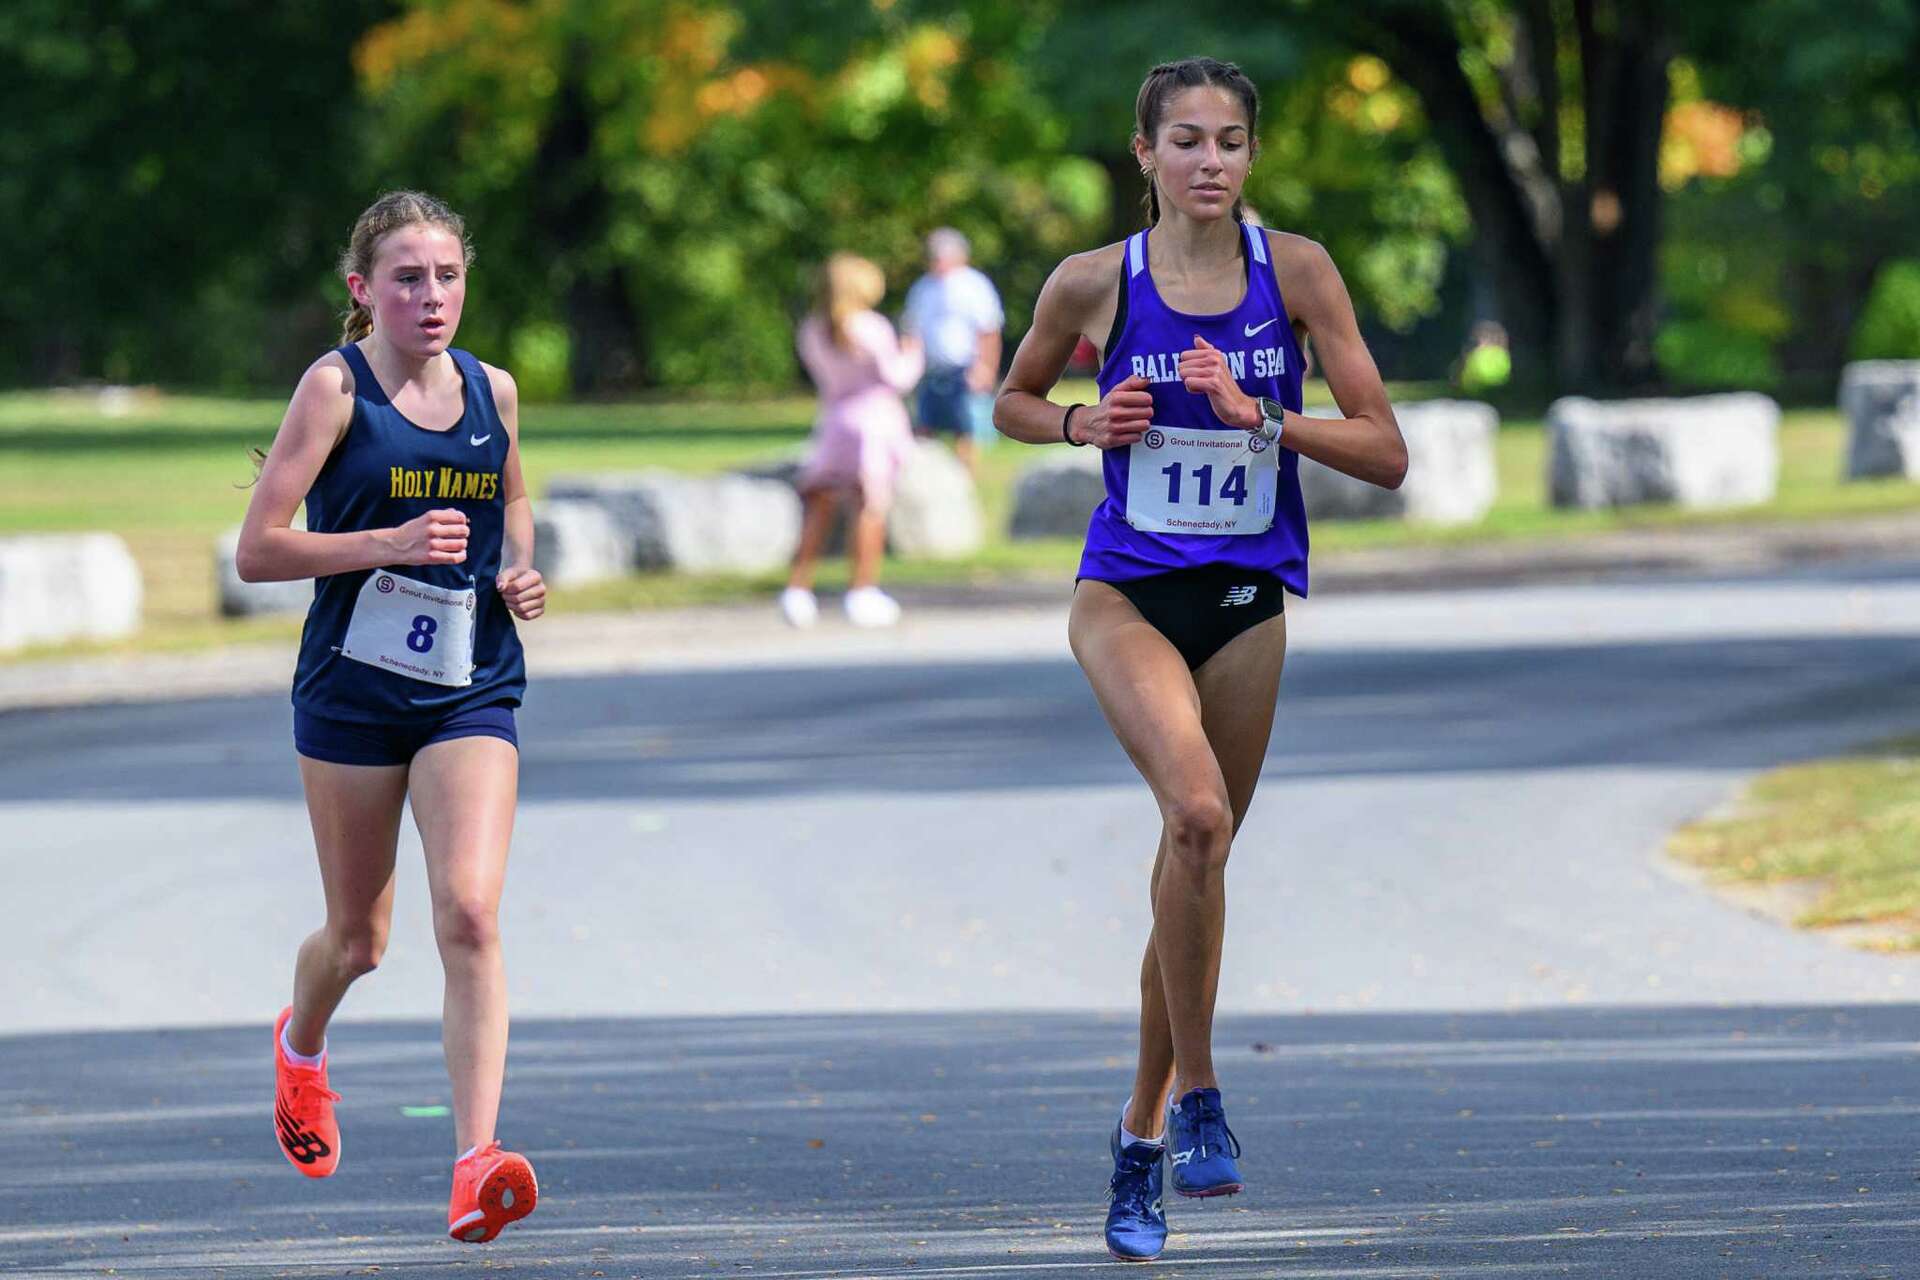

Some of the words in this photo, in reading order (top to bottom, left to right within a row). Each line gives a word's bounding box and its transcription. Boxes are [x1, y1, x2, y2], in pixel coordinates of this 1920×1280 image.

[1131, 352, 1246, 383] BALLN
[1252, 347, 1286, 379] SPA
[1170, 437, 1195, 448] Grout
[1197, 439, 1243, 449] Invitational
[389, 466, 435, 498] HOLY
[437, 466, 499, 500] NAMES
[1161, 461, 1249, 506] 114
[1166, 518, 1223, 530] Schenectady,
[1224, 520, 1237, 529] NY
[399, 585, 422, 599] Grout
[422, 592, 464, 608] Invitational
[406, 614, 438, 654] 8
[432, 669, 446, 679] NY
